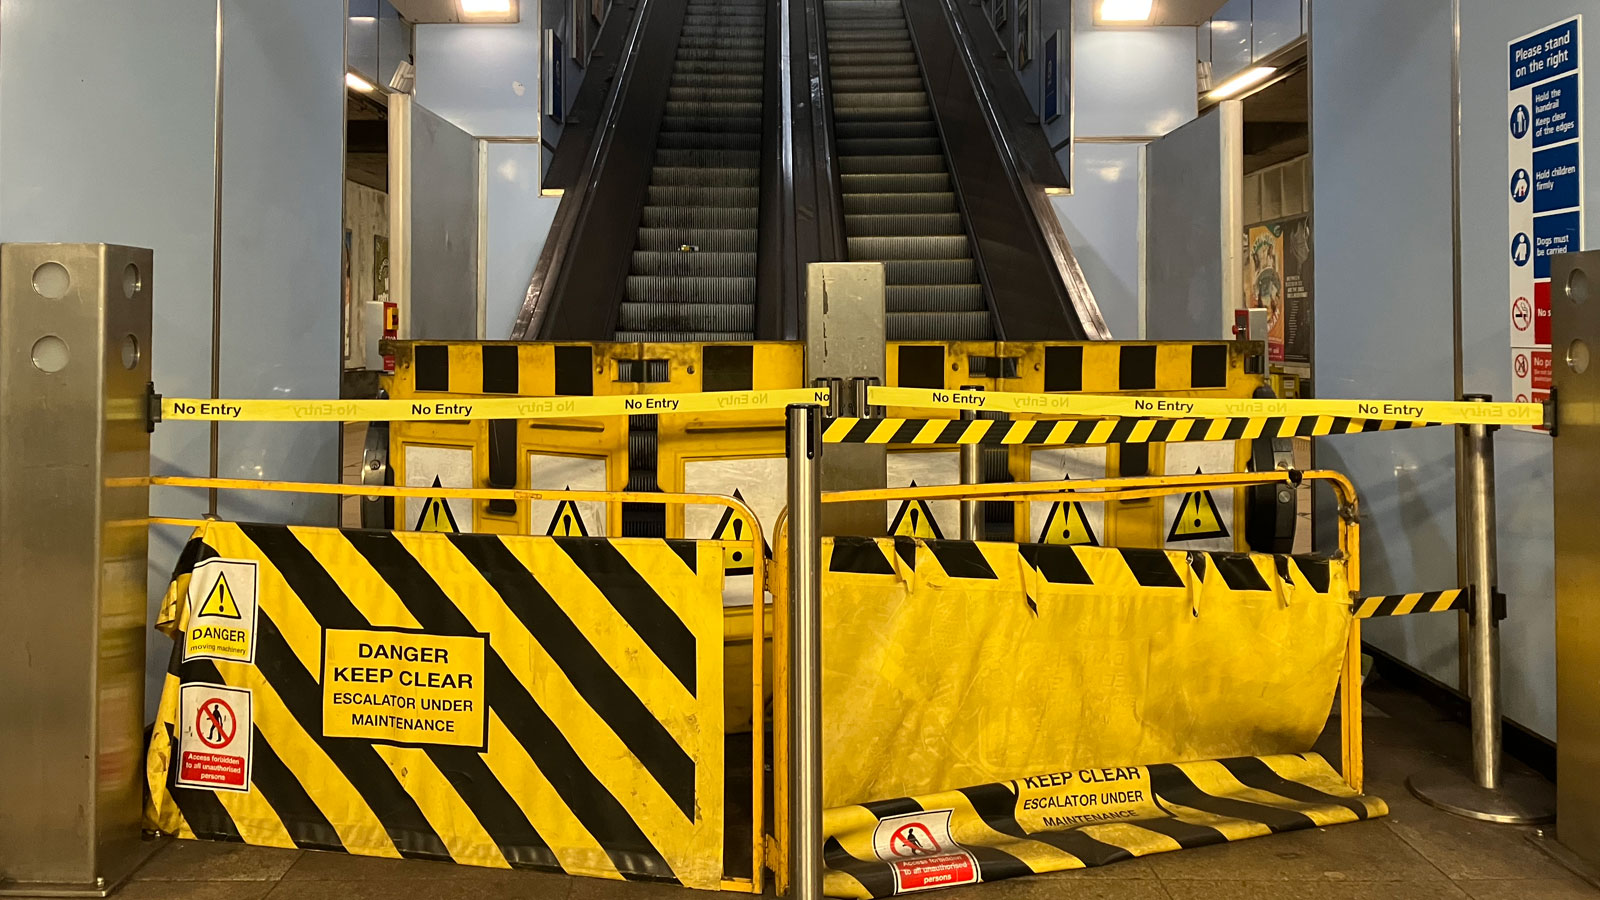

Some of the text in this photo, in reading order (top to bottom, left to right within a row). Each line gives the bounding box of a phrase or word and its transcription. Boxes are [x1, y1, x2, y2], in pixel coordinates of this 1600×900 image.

[1516, 30, 1570, 62] Please stand
[1516, 50, 1568, 78] on the right
[1536, 89, 1561, 102] Hold the
[1536, 99, 1559, 114] handrail
[1536, 112, 1566, 128] Keep clear
[1536, 120, 1574, 137] of the edges
[1536, 165, 1575, 180] Hold children
[1536, 180, 1554, 190] firmly
[1536, 234, 1569, 247] Dogs must
[1537, 244, 1568, 256] be carried
[1538, 308, 1546, 317] No
[1534, 357, 1543, 366] No
[814, 392, 830, 401] No
[932, 393, 986, 406] No Entry
[174, 403, 242, 417] No Entry
[412, 404, 472, 417] No Entry
[625, 398, 679, 410] No Entry
[1134, 400, 1194, 412] No Entry
[1358, 404, 1423, 417] No Entry
[193, 627, 245, 642] DANGER
[217, 644, 246, 655] machinery
[359, 643, 448, 664] DANGER
[334, 667, 473, 689] KEEP CLEAR
[334, 693, 473, 712] ESCALATOR UNDER
[352, 714, 454, 732] MAINTENANCE
[188, 753, 240, 765] Access forbidden
[202, 764, 240, 773] unauthorised
[1024, 767, 1140, 789] KEEP CLEAR
[1023, 790, 1144, 810] ESCALATOR UNDER
[1042, 810, 1140, 826] MAINTENANCE
[923, 862, 968, 872] unauthorised
[923, 874, 952, 884] persons
